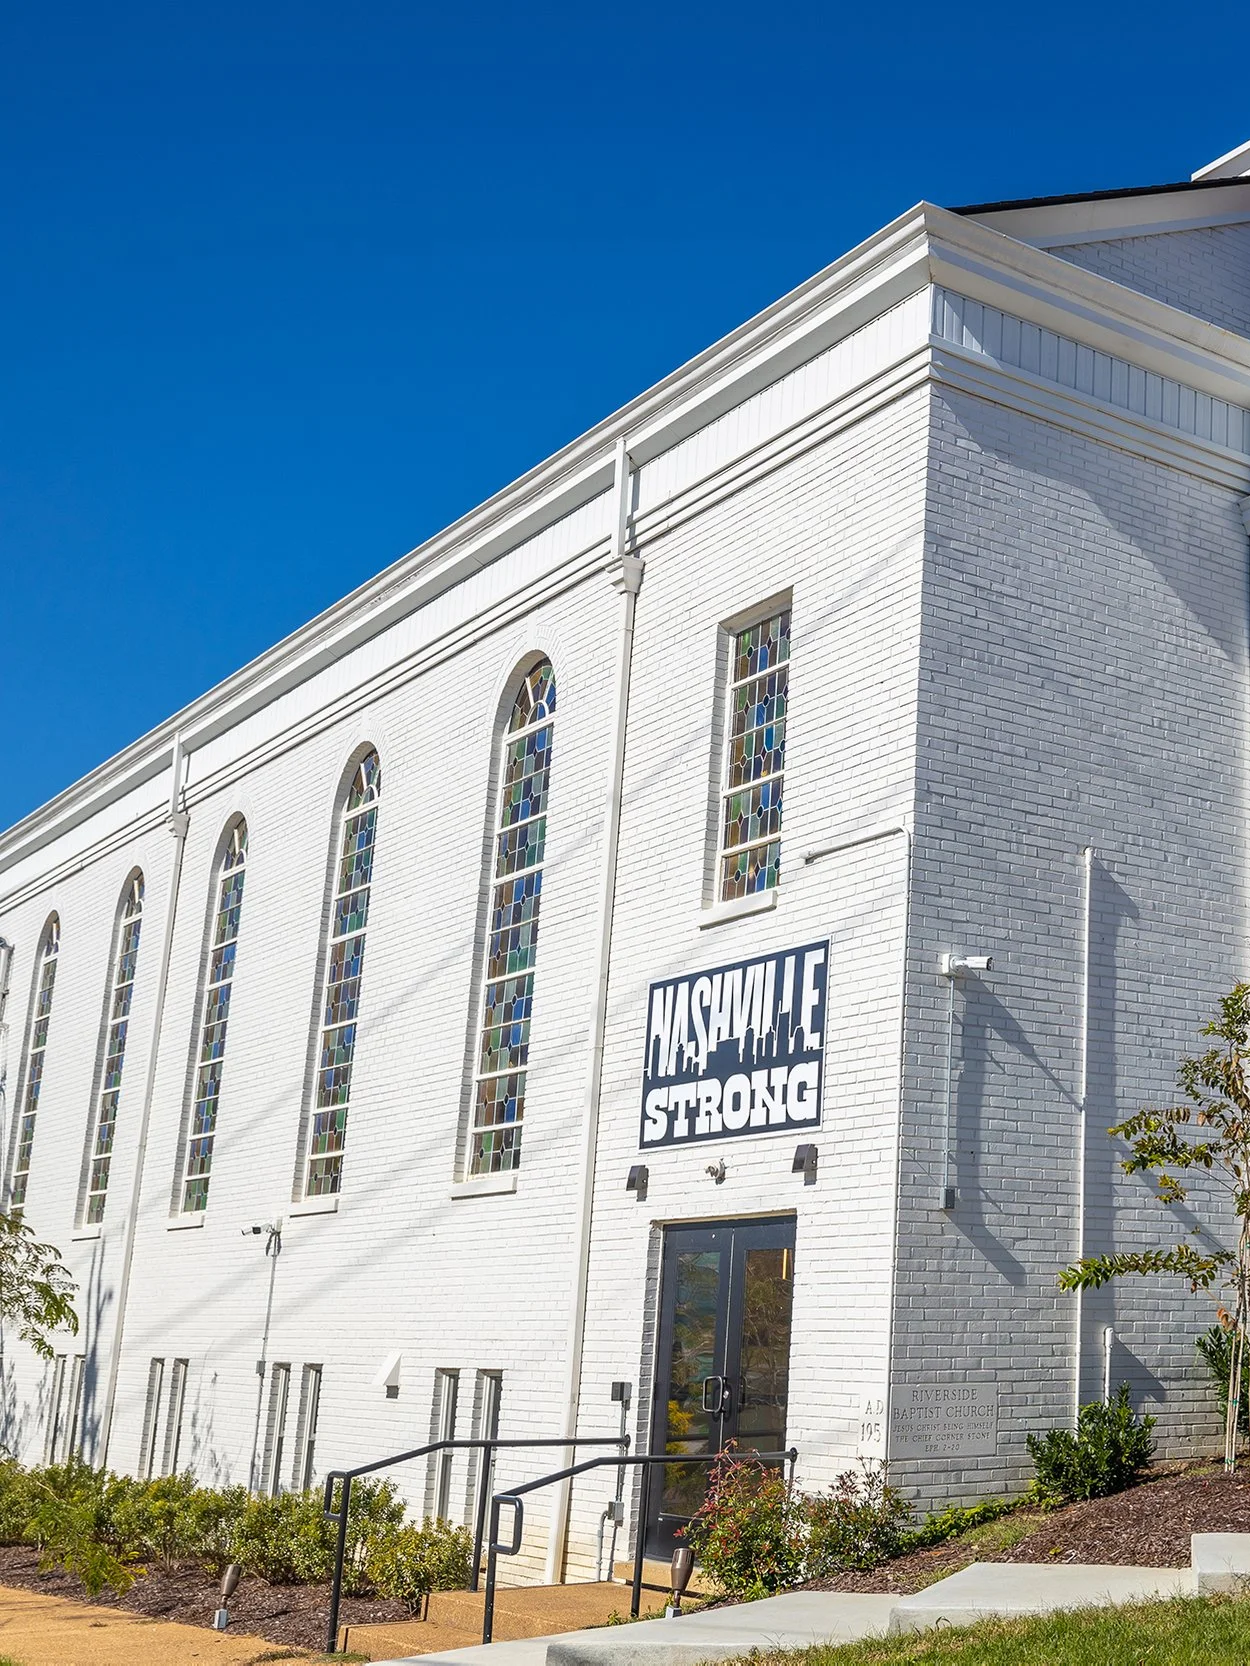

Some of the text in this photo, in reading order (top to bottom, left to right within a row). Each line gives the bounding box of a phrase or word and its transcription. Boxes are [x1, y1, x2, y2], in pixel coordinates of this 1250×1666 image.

[645, 948, 825, 1080] NASHVILLE
[643, 1060, 820, 1143] STRONG
[912, 1388, 978, 1402] RIVERSIDE
[893, 1404, 994, 1420] BAPTIST CHURCH
[892, 1421, 994, 1433] JESUS CHRIST BEING HIMSELF
[895, 1431, 991, 1443] THE CHIEF CORNER STONE
